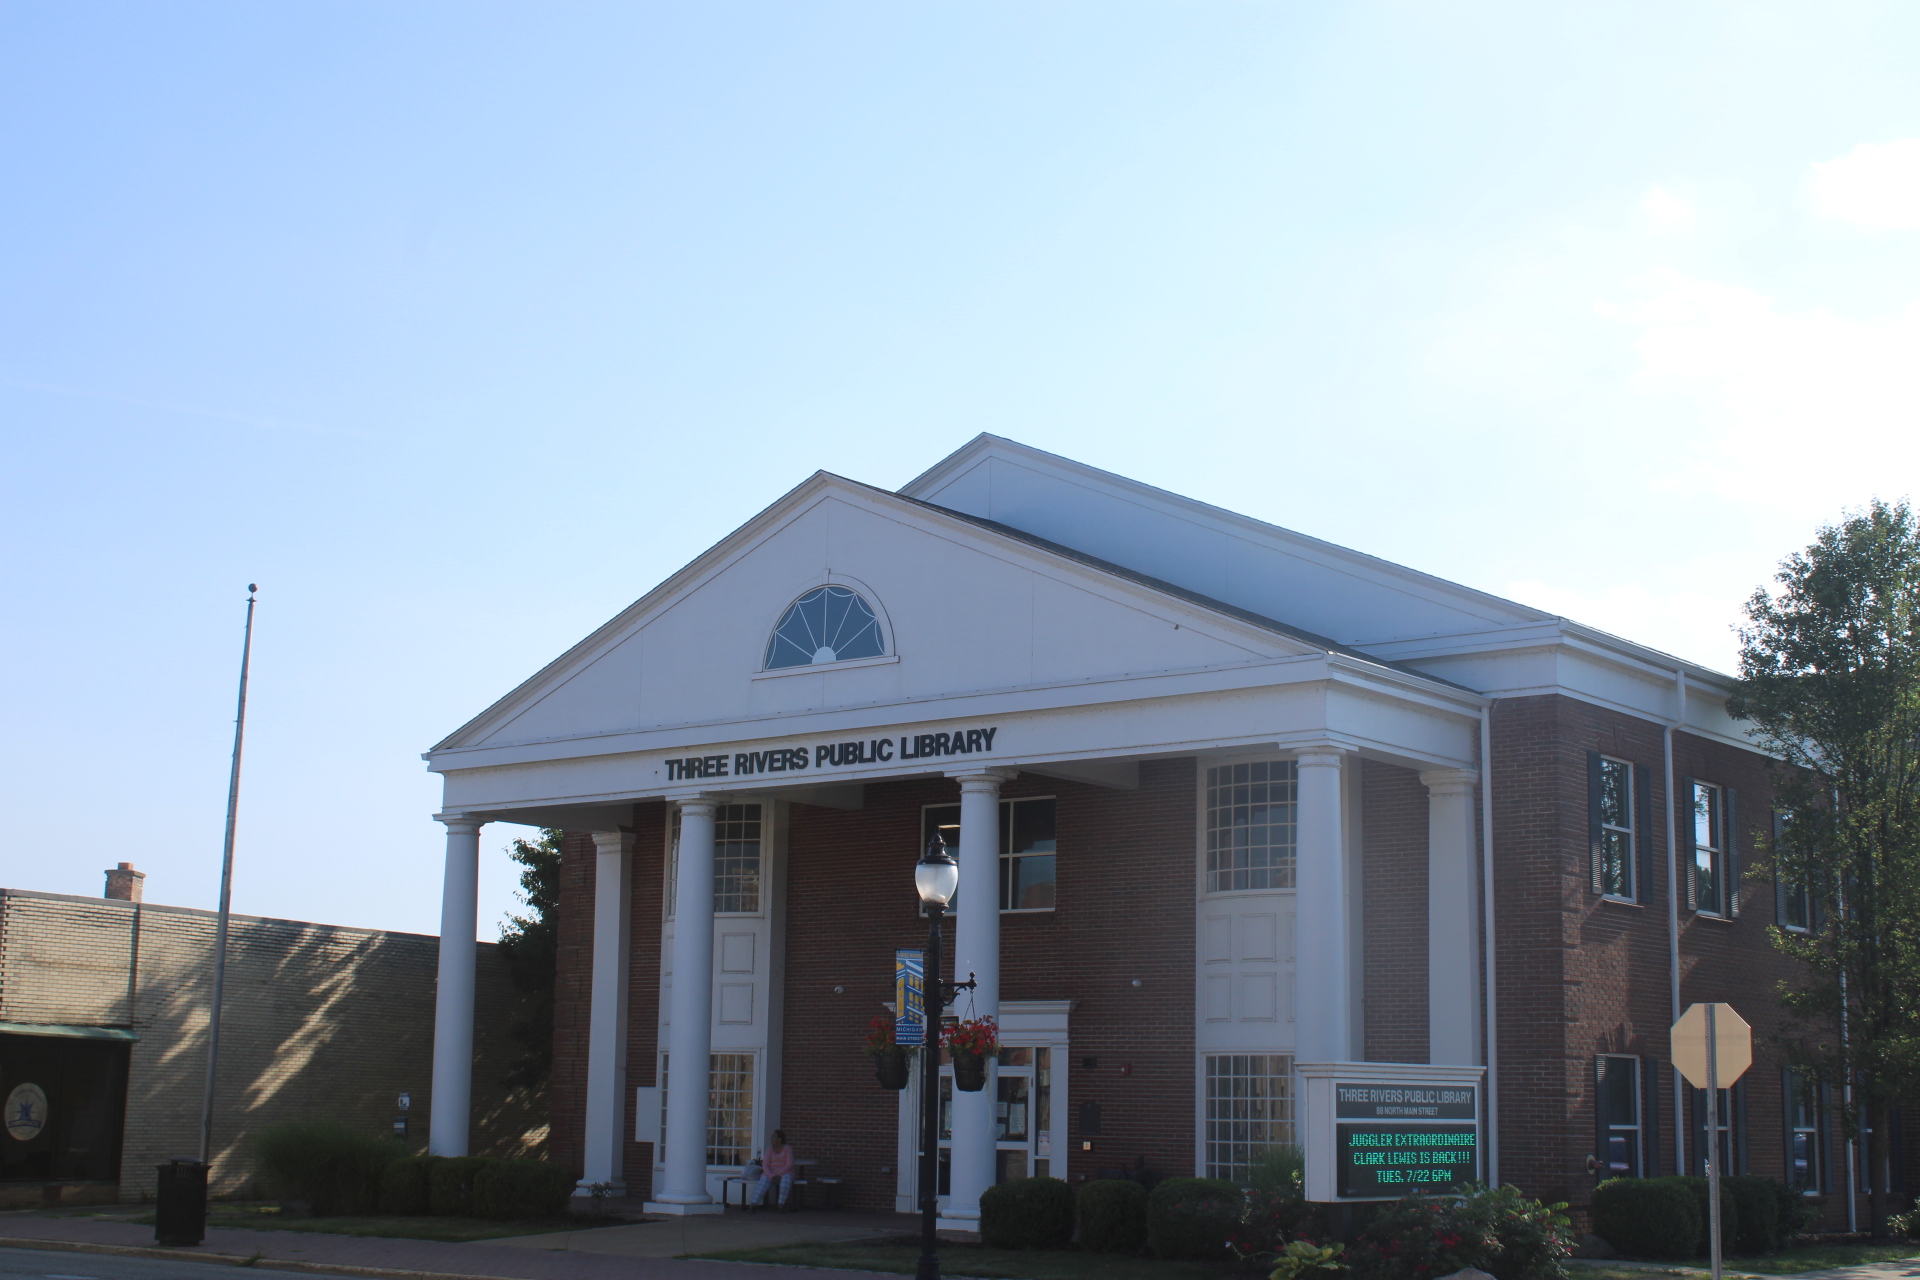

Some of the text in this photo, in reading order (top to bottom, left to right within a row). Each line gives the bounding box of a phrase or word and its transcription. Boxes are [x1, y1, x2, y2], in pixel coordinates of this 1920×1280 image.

[665, 727, 997, 781] THREE RIVERS PUBLIC LIBRARY
[1339, 1088, 1471, 1104] THREE RIVERS PUBLIC LIBRARY
[1376, 1106, 1438, 1116] 88 NORTH MAIN STREET
[1348, 1133, 1475, 1147] JUGGLER EXTRAORDINAIRE
[1353, 1151, 1471, 1165] CLARK LEWIS IS BACK!!!
[1376, 1169, 1452, 1183] TUES. 7/22 6PM
